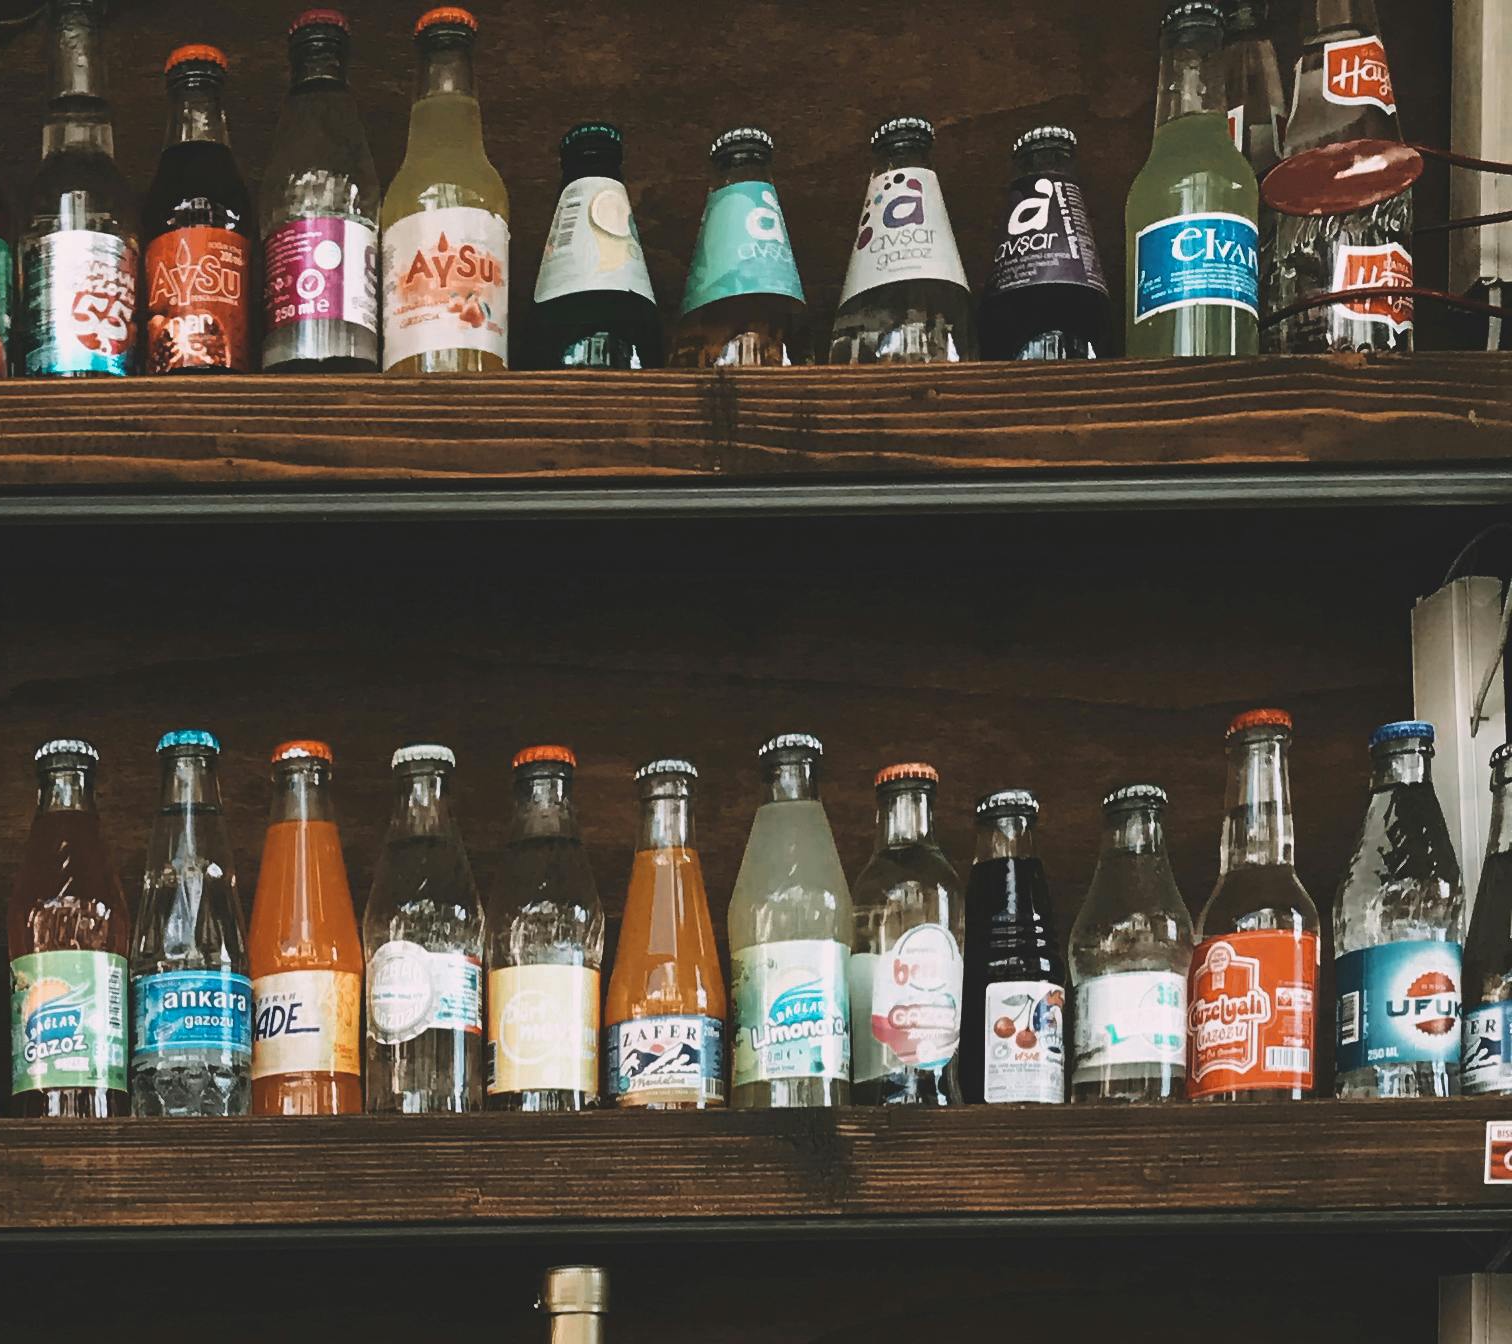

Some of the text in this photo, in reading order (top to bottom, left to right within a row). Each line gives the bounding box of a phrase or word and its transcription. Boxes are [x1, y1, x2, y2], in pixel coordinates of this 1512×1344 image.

[868, 226, 937, 258] avşar
[994, 233, 1059, 263] avşar
[875, 244, 932, 270] gazoz
[163, 990, 247, 1014] ankara
[1385, 997, 1465, 1019] UFUK
[184, 1014, 235, 1031] gazozu
[254, 1002, 320, 1041] ADE
[622, 1021, 697, 1047] ZAFER
